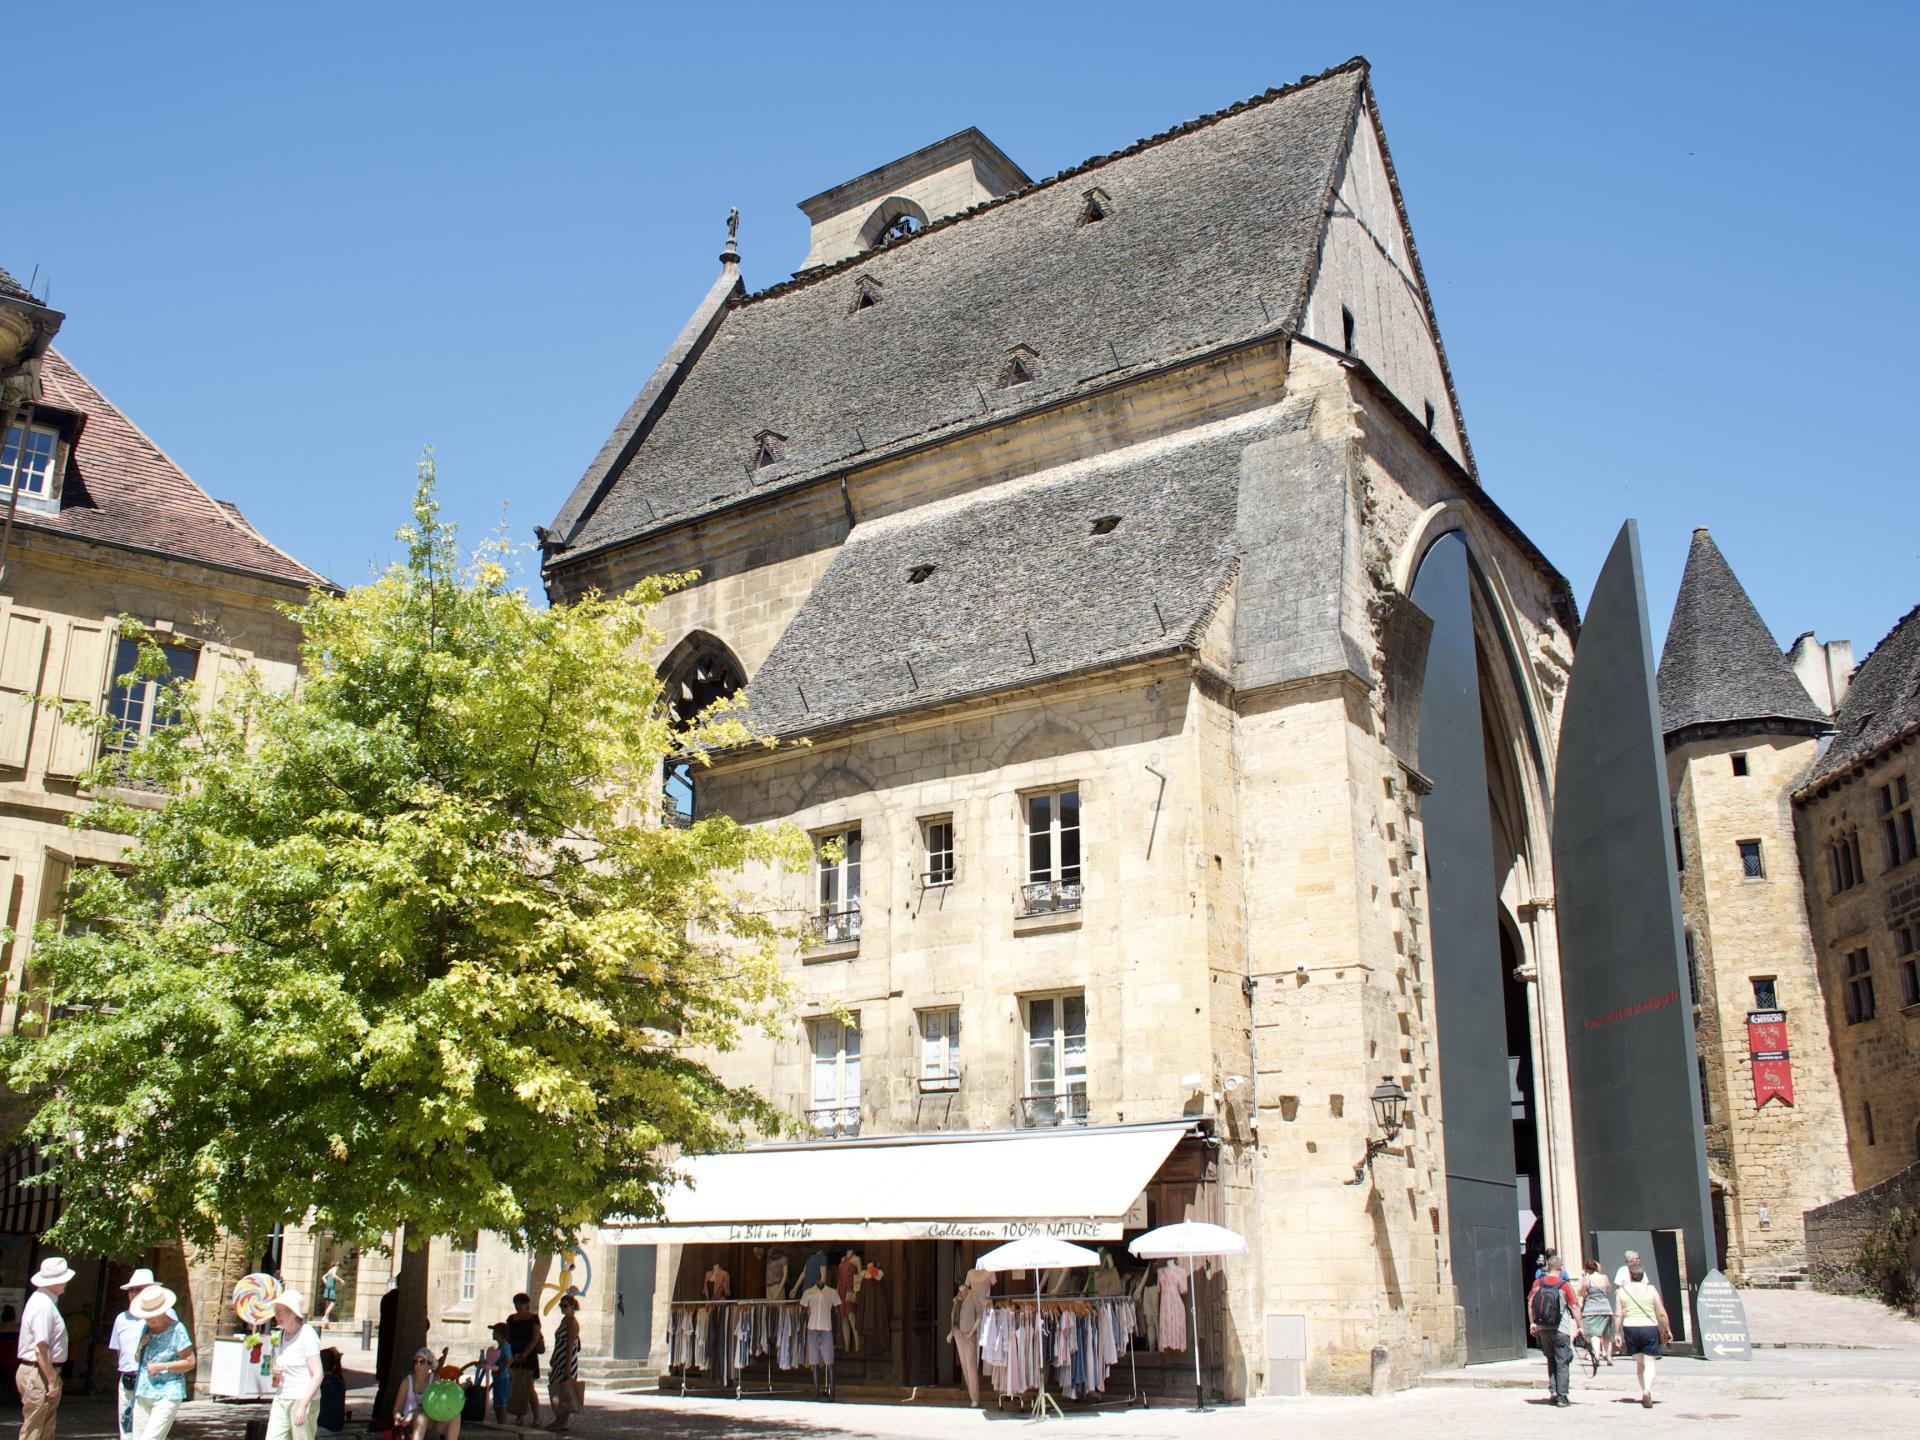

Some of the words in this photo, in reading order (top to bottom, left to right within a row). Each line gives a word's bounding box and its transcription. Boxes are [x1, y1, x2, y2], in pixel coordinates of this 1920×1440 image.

[928, 1223, 996, 1238] Collection
[1000, 1222, 1041, 1237] 100%
[1046, 1222, 1103, 1237] NATURE
[1705, 1333, 1746, 1342] OUVERT
